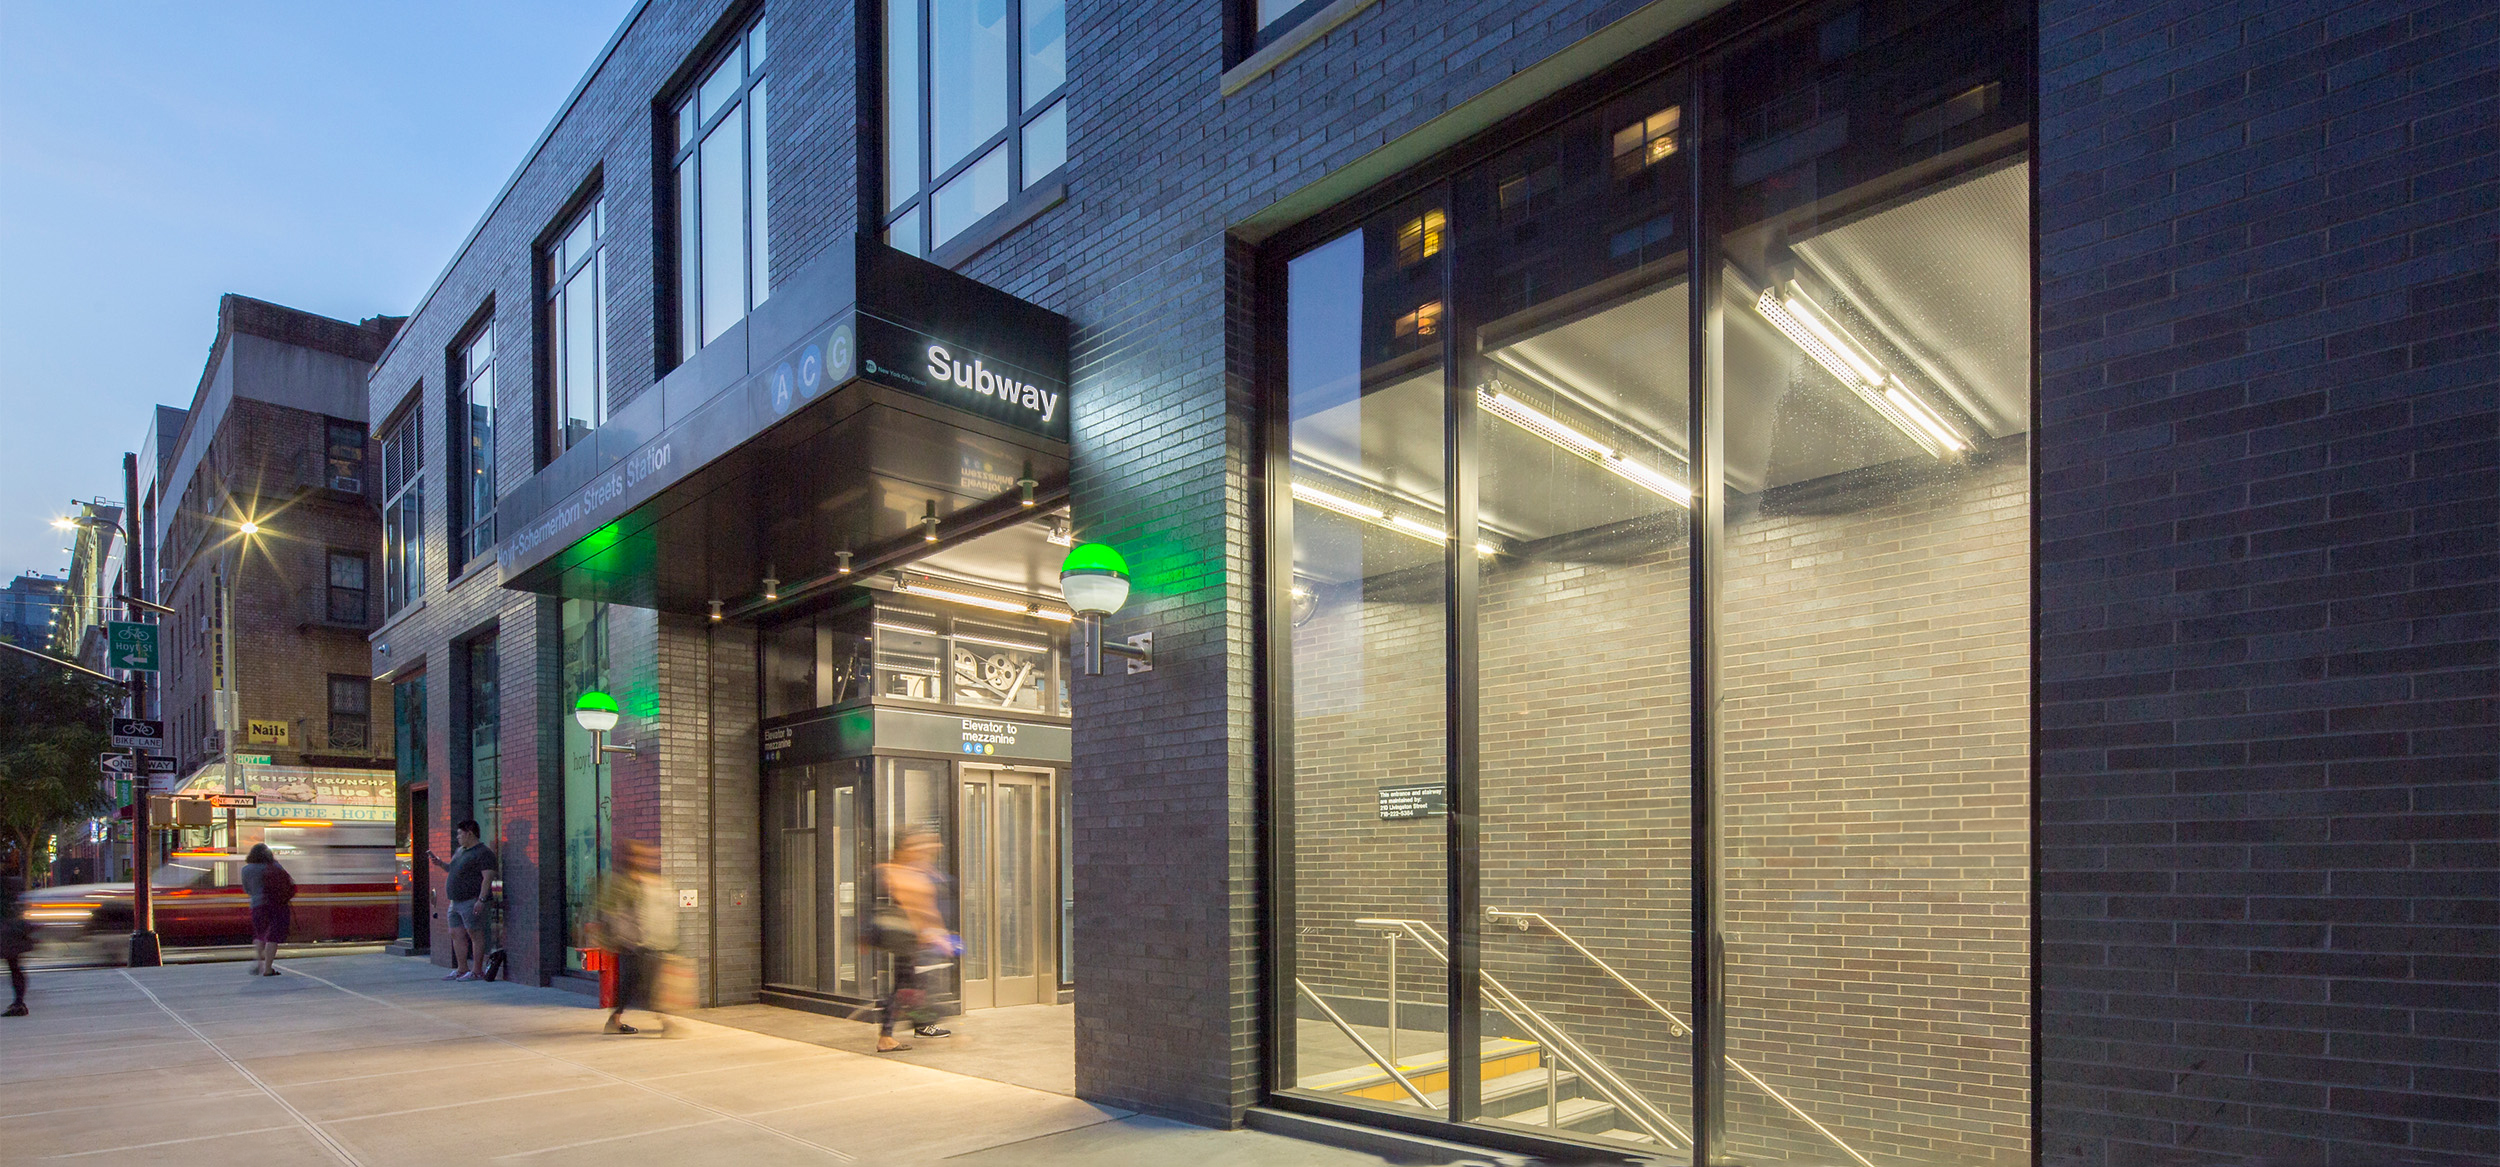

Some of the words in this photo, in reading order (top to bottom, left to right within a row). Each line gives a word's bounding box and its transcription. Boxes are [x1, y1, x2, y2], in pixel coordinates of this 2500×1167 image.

[878, 366, 889, 375] New
[889, 369, 901, 379] York
[928, 345, 1058, 422] Subway
[583, 473, 623, 515] Streets
[627, 442, 671, 488] Station
[115, 642, 140, 653] Hoyt
[142, 643, 153, 652] St
[252, 724, 286, 736] Nails
[962, 719, 1003, 733] Elevator
[1007, 723, 1018, 735] to
[115, 736, 135, 745] BIKE
[138, 738, 161, 747] LANE
[962, 732, 1015, 744] mezzanine
[112, 759, 133, 768] ONE
[148, 761, 171, 769] WAY
[237, 755, 260, 764] HOYT
[247, 775, 308, 783] KRISPY
[312, 777, 388, 786] KRUNCHY
[316, 786, 370, 797] Blue
[256, 806, 327, 818] COFFEE
[342, 809, 376, 819] HOT
